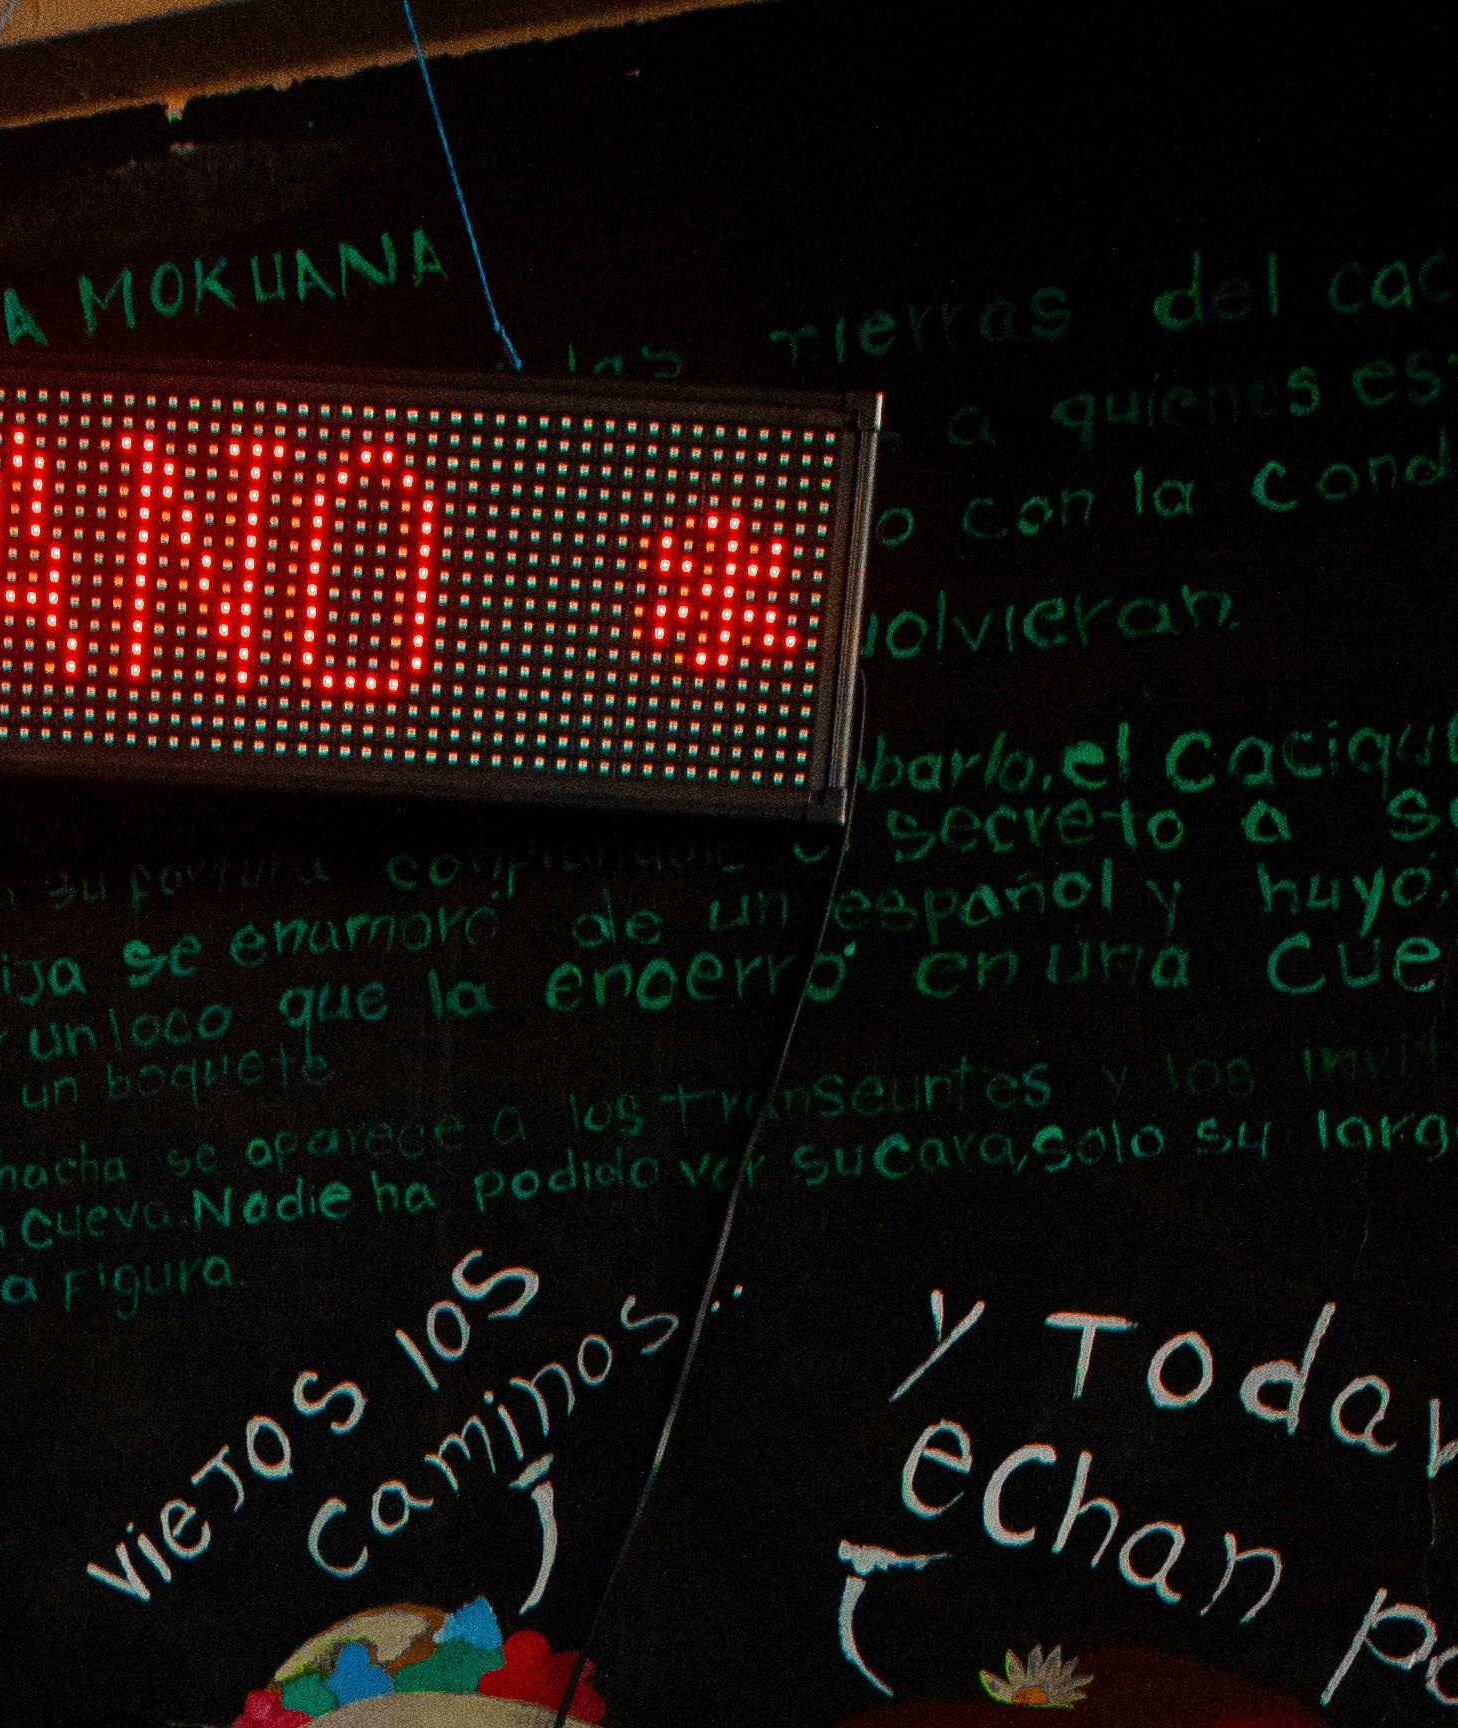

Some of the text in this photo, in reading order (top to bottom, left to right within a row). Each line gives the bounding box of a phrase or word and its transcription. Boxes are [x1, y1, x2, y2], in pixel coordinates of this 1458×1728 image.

[77, 224, 446, 337] MOKUANA
[1150, 248, 1282, 332] del
[1048, 364, 1324, 450] quienes
[1348, 350, 1458, 410] es
[959, 482, 1097, 542] con
[1130, 464, 1197, 520] la
[884, 797, 1188, 866] secreto
[1238, 798, 1294, 848] a
[1384, 784, 1458, 844] s
[120, 932, 206, 990] se
[570, 886, 666, 950] de
[706, 888, 792, 934] un
[832, 855, 1118, 946] español
[1144, 876, 1184, 938] y
[277, 960, 392, 1070] que
[425, 966, 494, 1022] la
[910, 942, 1022, 1000] en
[1044, 938, 1194, 992] una
[1264, 930, 1458, 998] Cue
[368, 1166, 439, 1217] ha
[470, 1144, 666, 1214] podido
[898, 1418, 1286, 1626] echan
